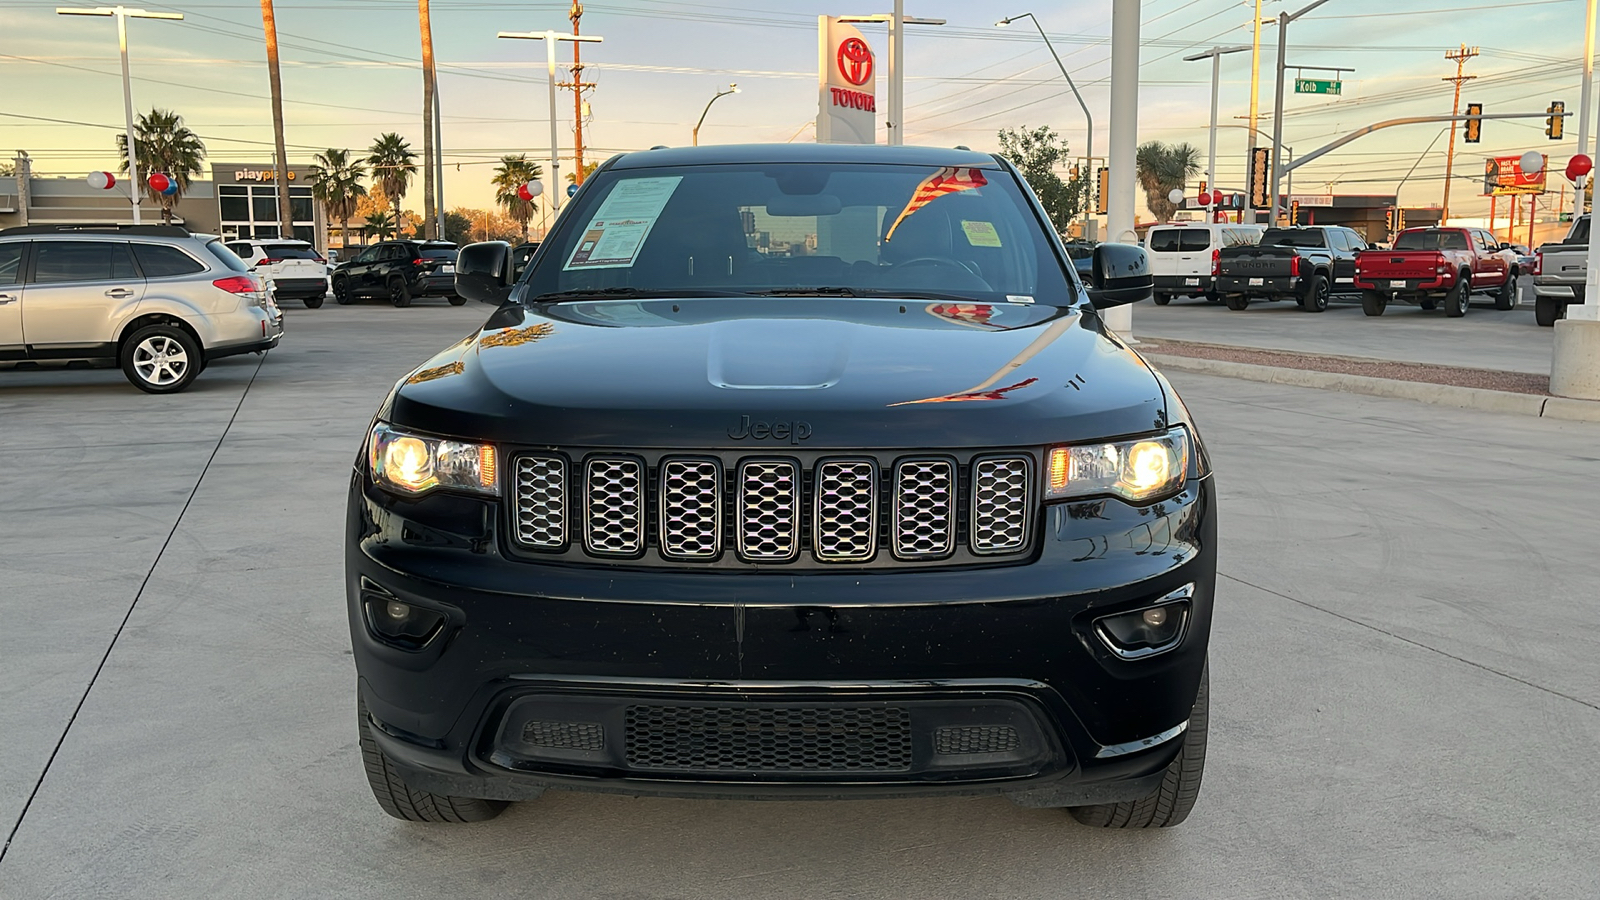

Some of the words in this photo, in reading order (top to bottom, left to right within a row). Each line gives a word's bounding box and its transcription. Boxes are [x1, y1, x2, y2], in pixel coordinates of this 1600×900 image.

[1300, 81, 1316, 92] Kolb
[830, 88, 876, 112] TOYOTA
[235, 168, 295, 182] playple
[727, 414, 812, 445] Jeep
